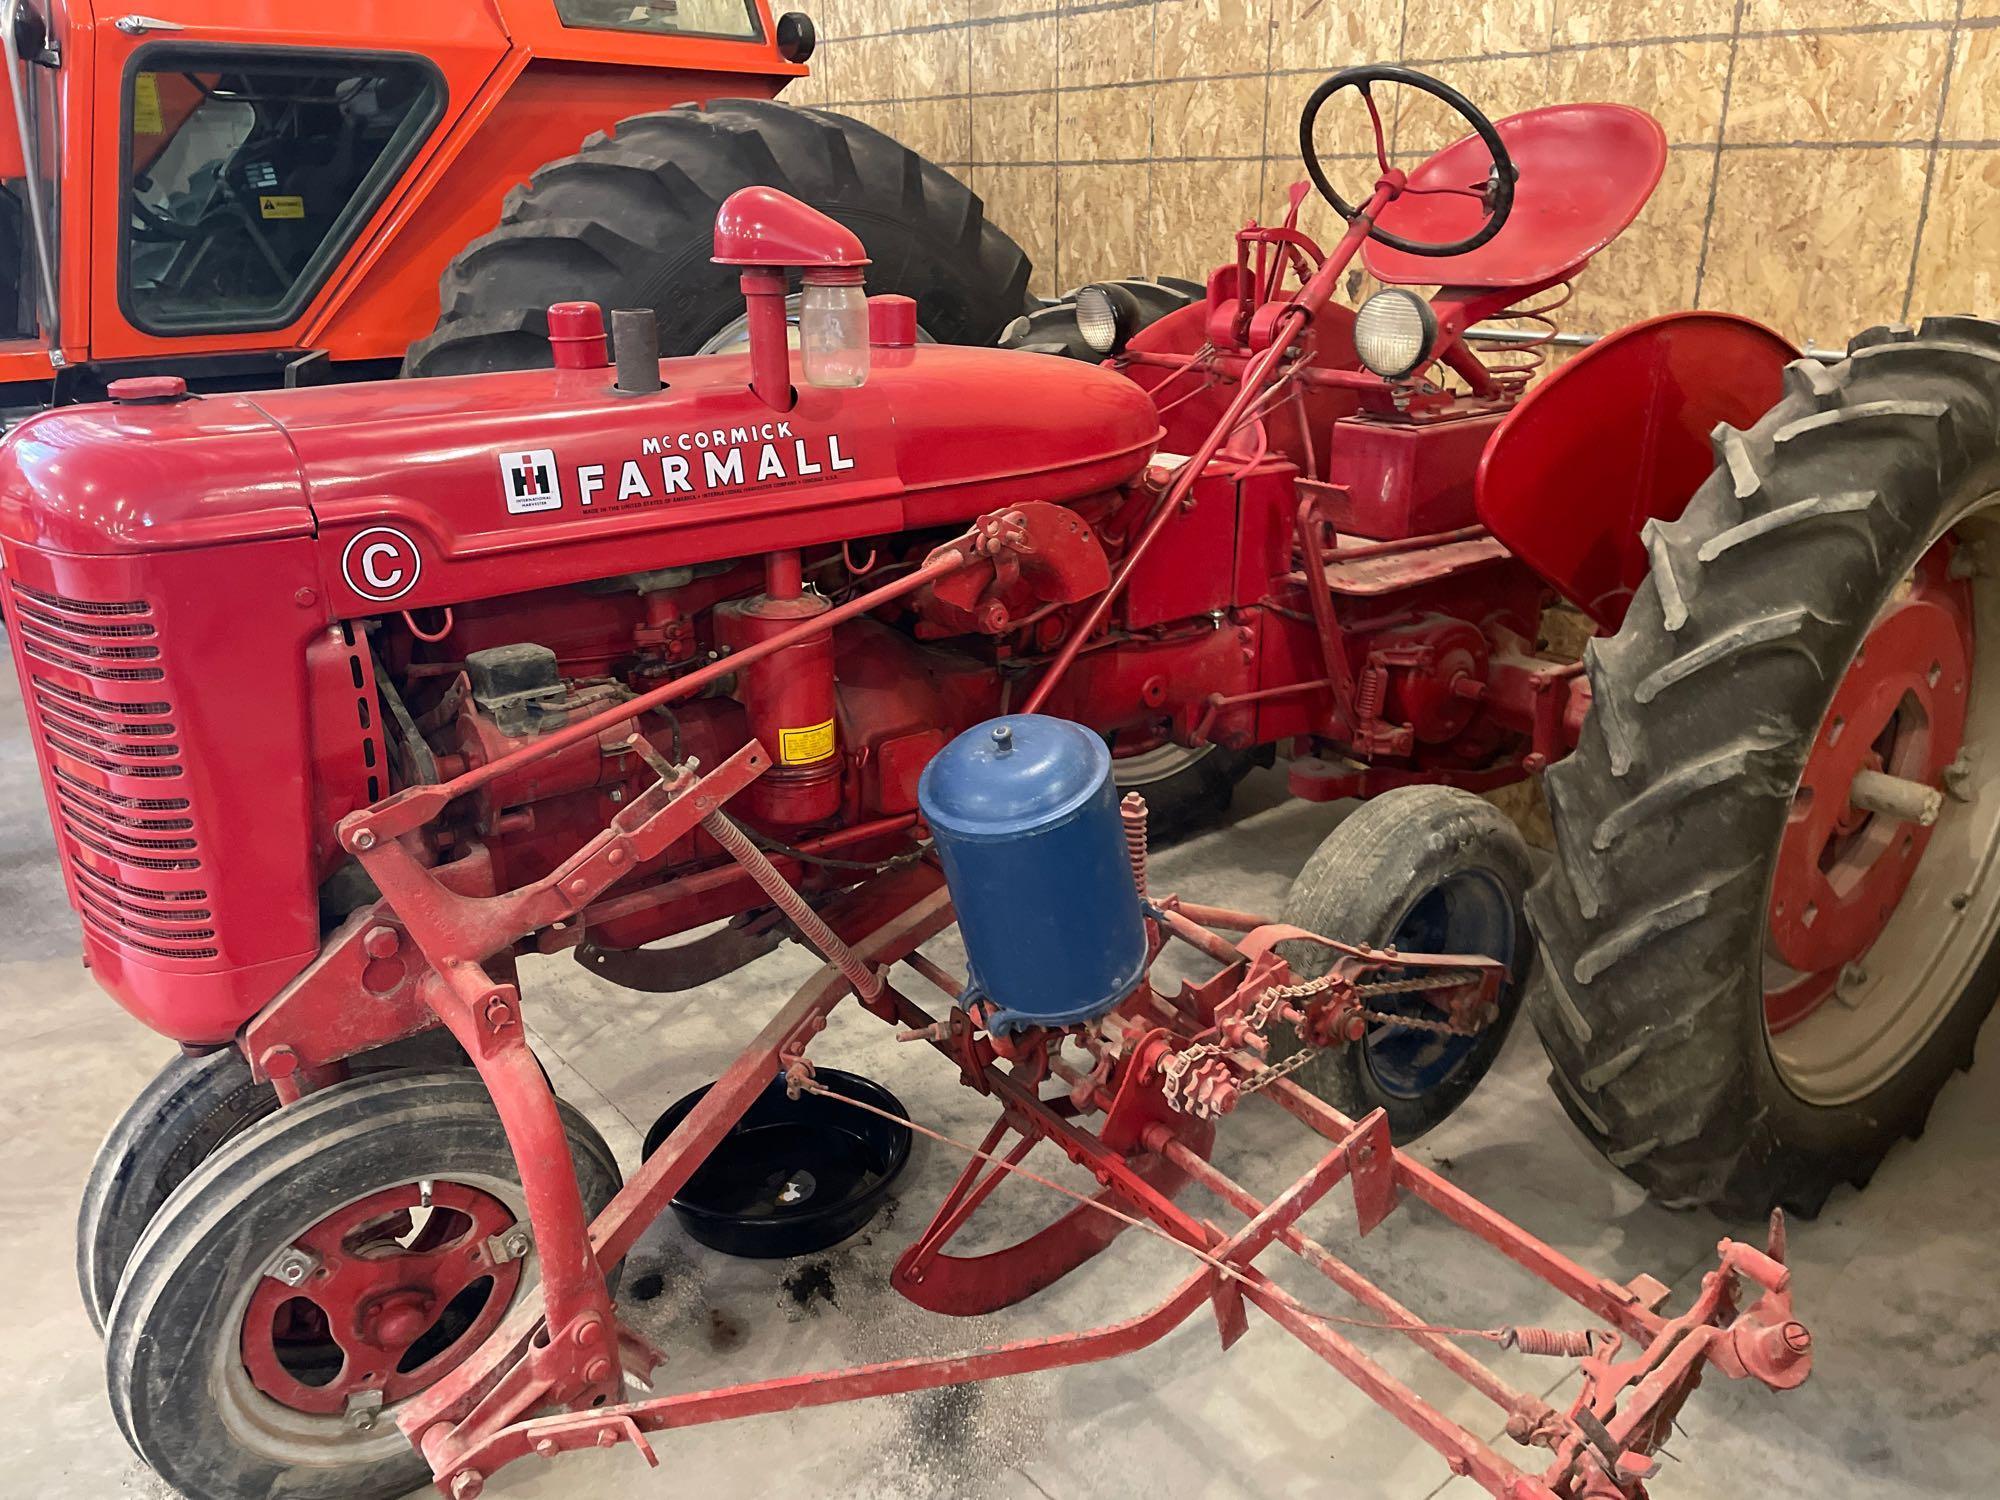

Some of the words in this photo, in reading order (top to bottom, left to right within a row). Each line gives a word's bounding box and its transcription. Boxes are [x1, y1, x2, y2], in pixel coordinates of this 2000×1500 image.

[577, 434, 854, 506] FARMALL
[672, 495, 697, 503] AMERICA
[701, 488, 743, 498] INTERNATIONAL
[362, 542, 403, 588] C
